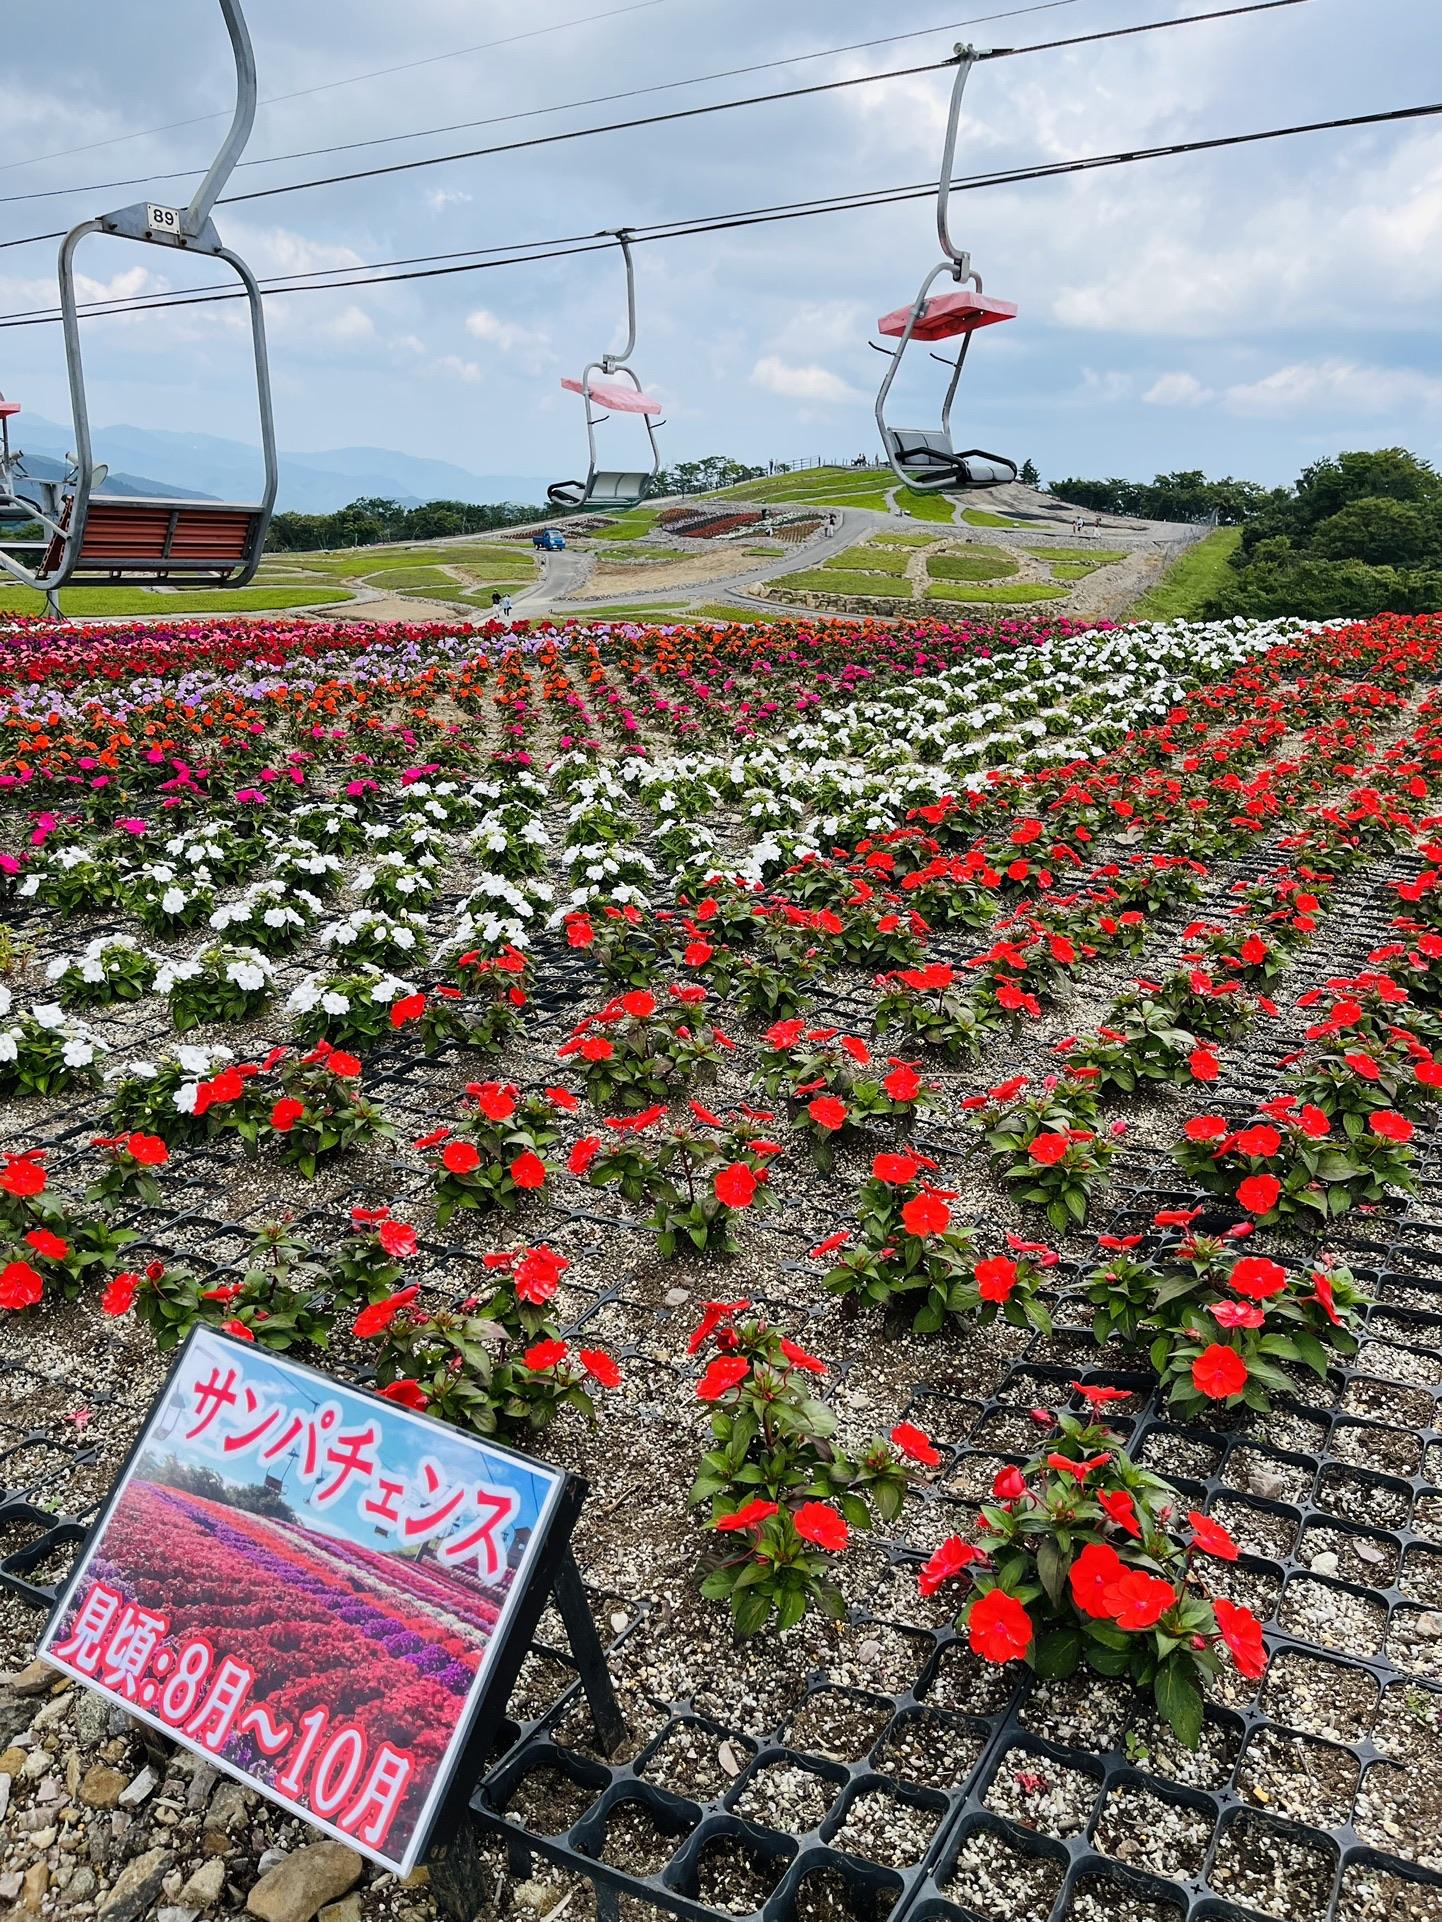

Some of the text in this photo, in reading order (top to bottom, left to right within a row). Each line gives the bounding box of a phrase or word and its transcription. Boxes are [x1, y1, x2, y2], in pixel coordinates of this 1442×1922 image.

[153, 209, 174, 226] 89
[183, 1364, 515, 1577] サンパチェンス
